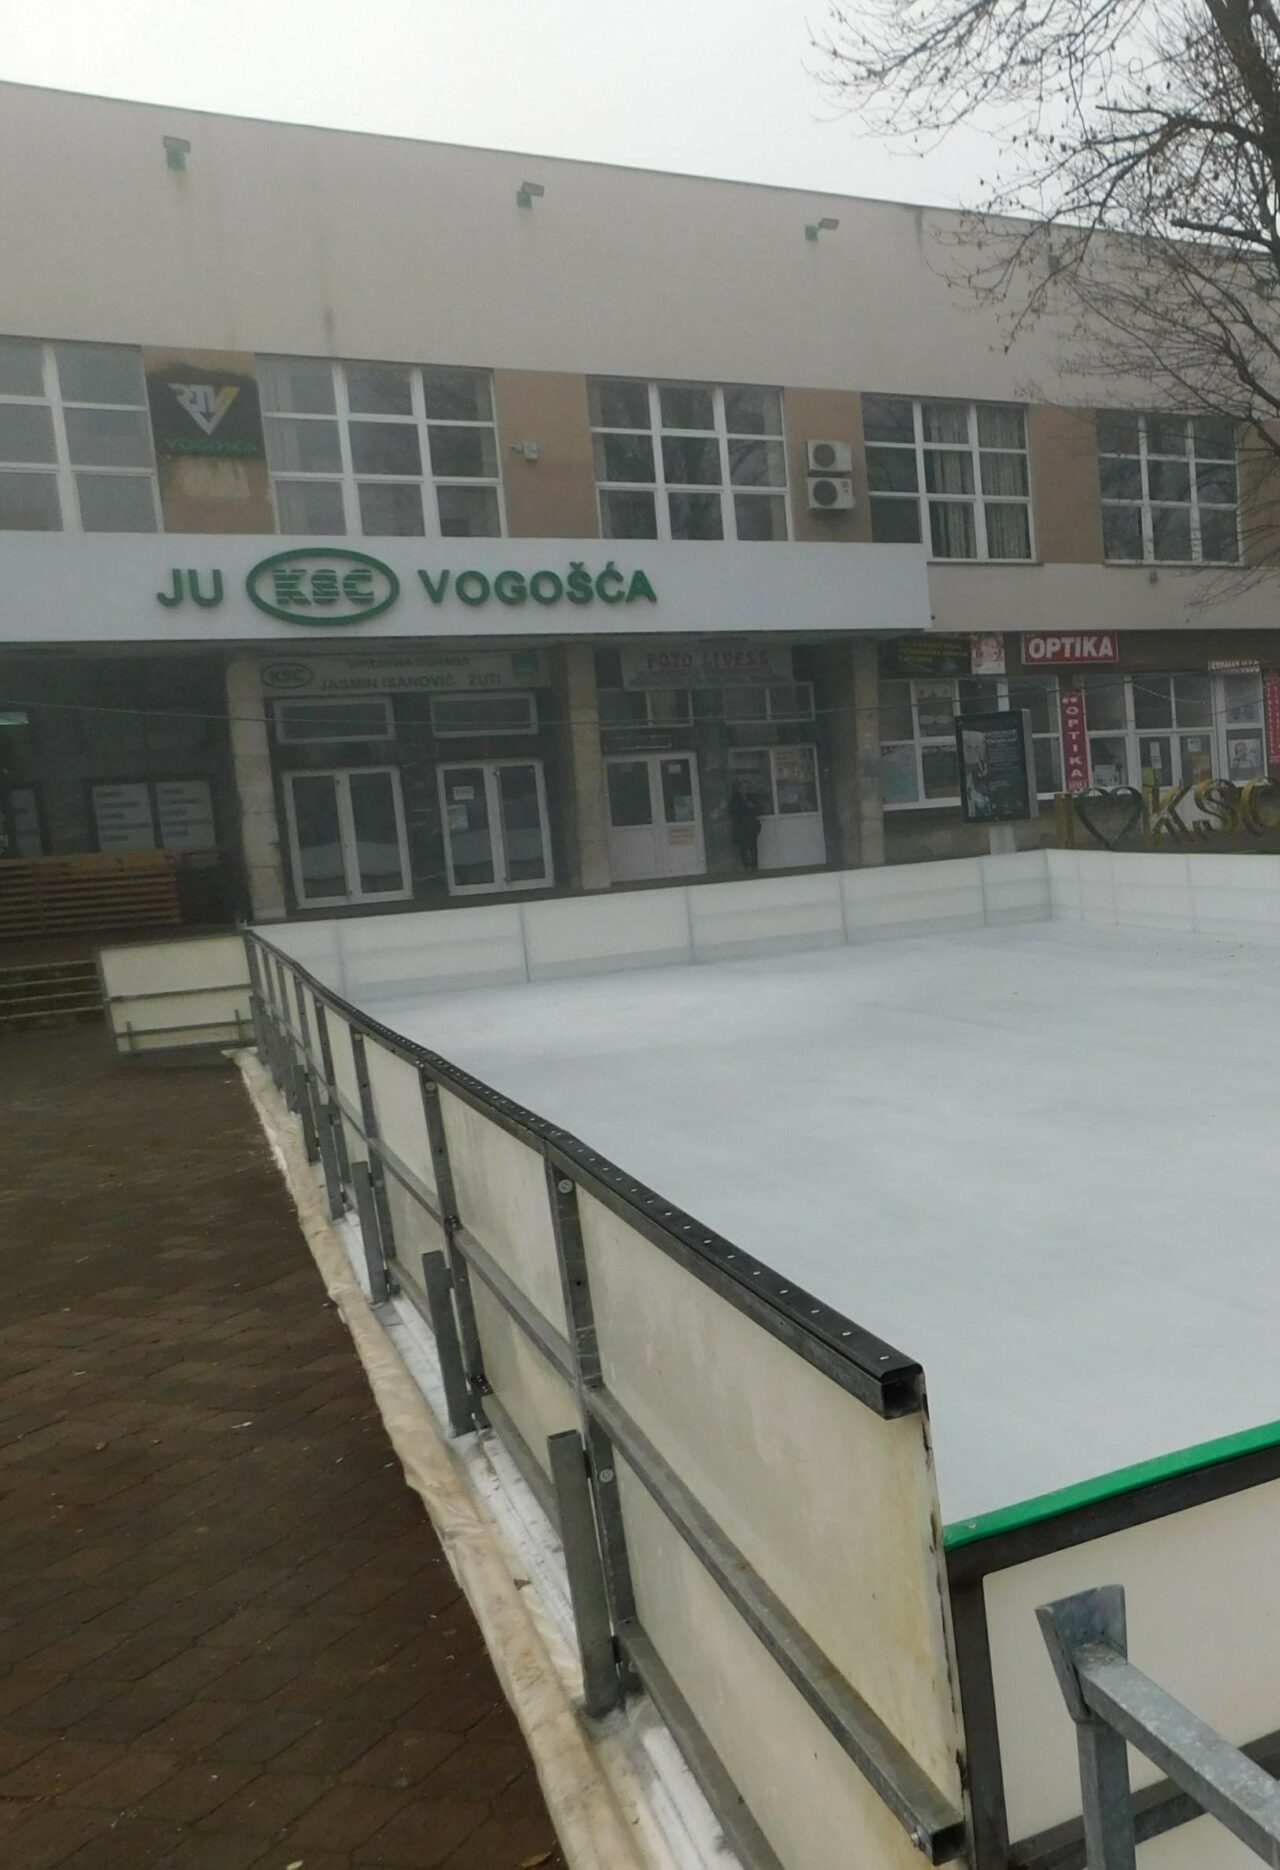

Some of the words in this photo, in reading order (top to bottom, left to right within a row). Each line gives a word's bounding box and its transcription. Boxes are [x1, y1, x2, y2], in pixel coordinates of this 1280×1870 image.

[157, 568, 224, 608] JU
[273, 569, 375, 606] KSC
[417, 561, 657, 606] VOGOŠĆA
[1028, 635, 1114, 659] OPTIKA
[646, 651, 693, 669] FOTO
[319, 677, 378, 691] JASMIN
[1066, 706, 1083, 777] OPTIKA
